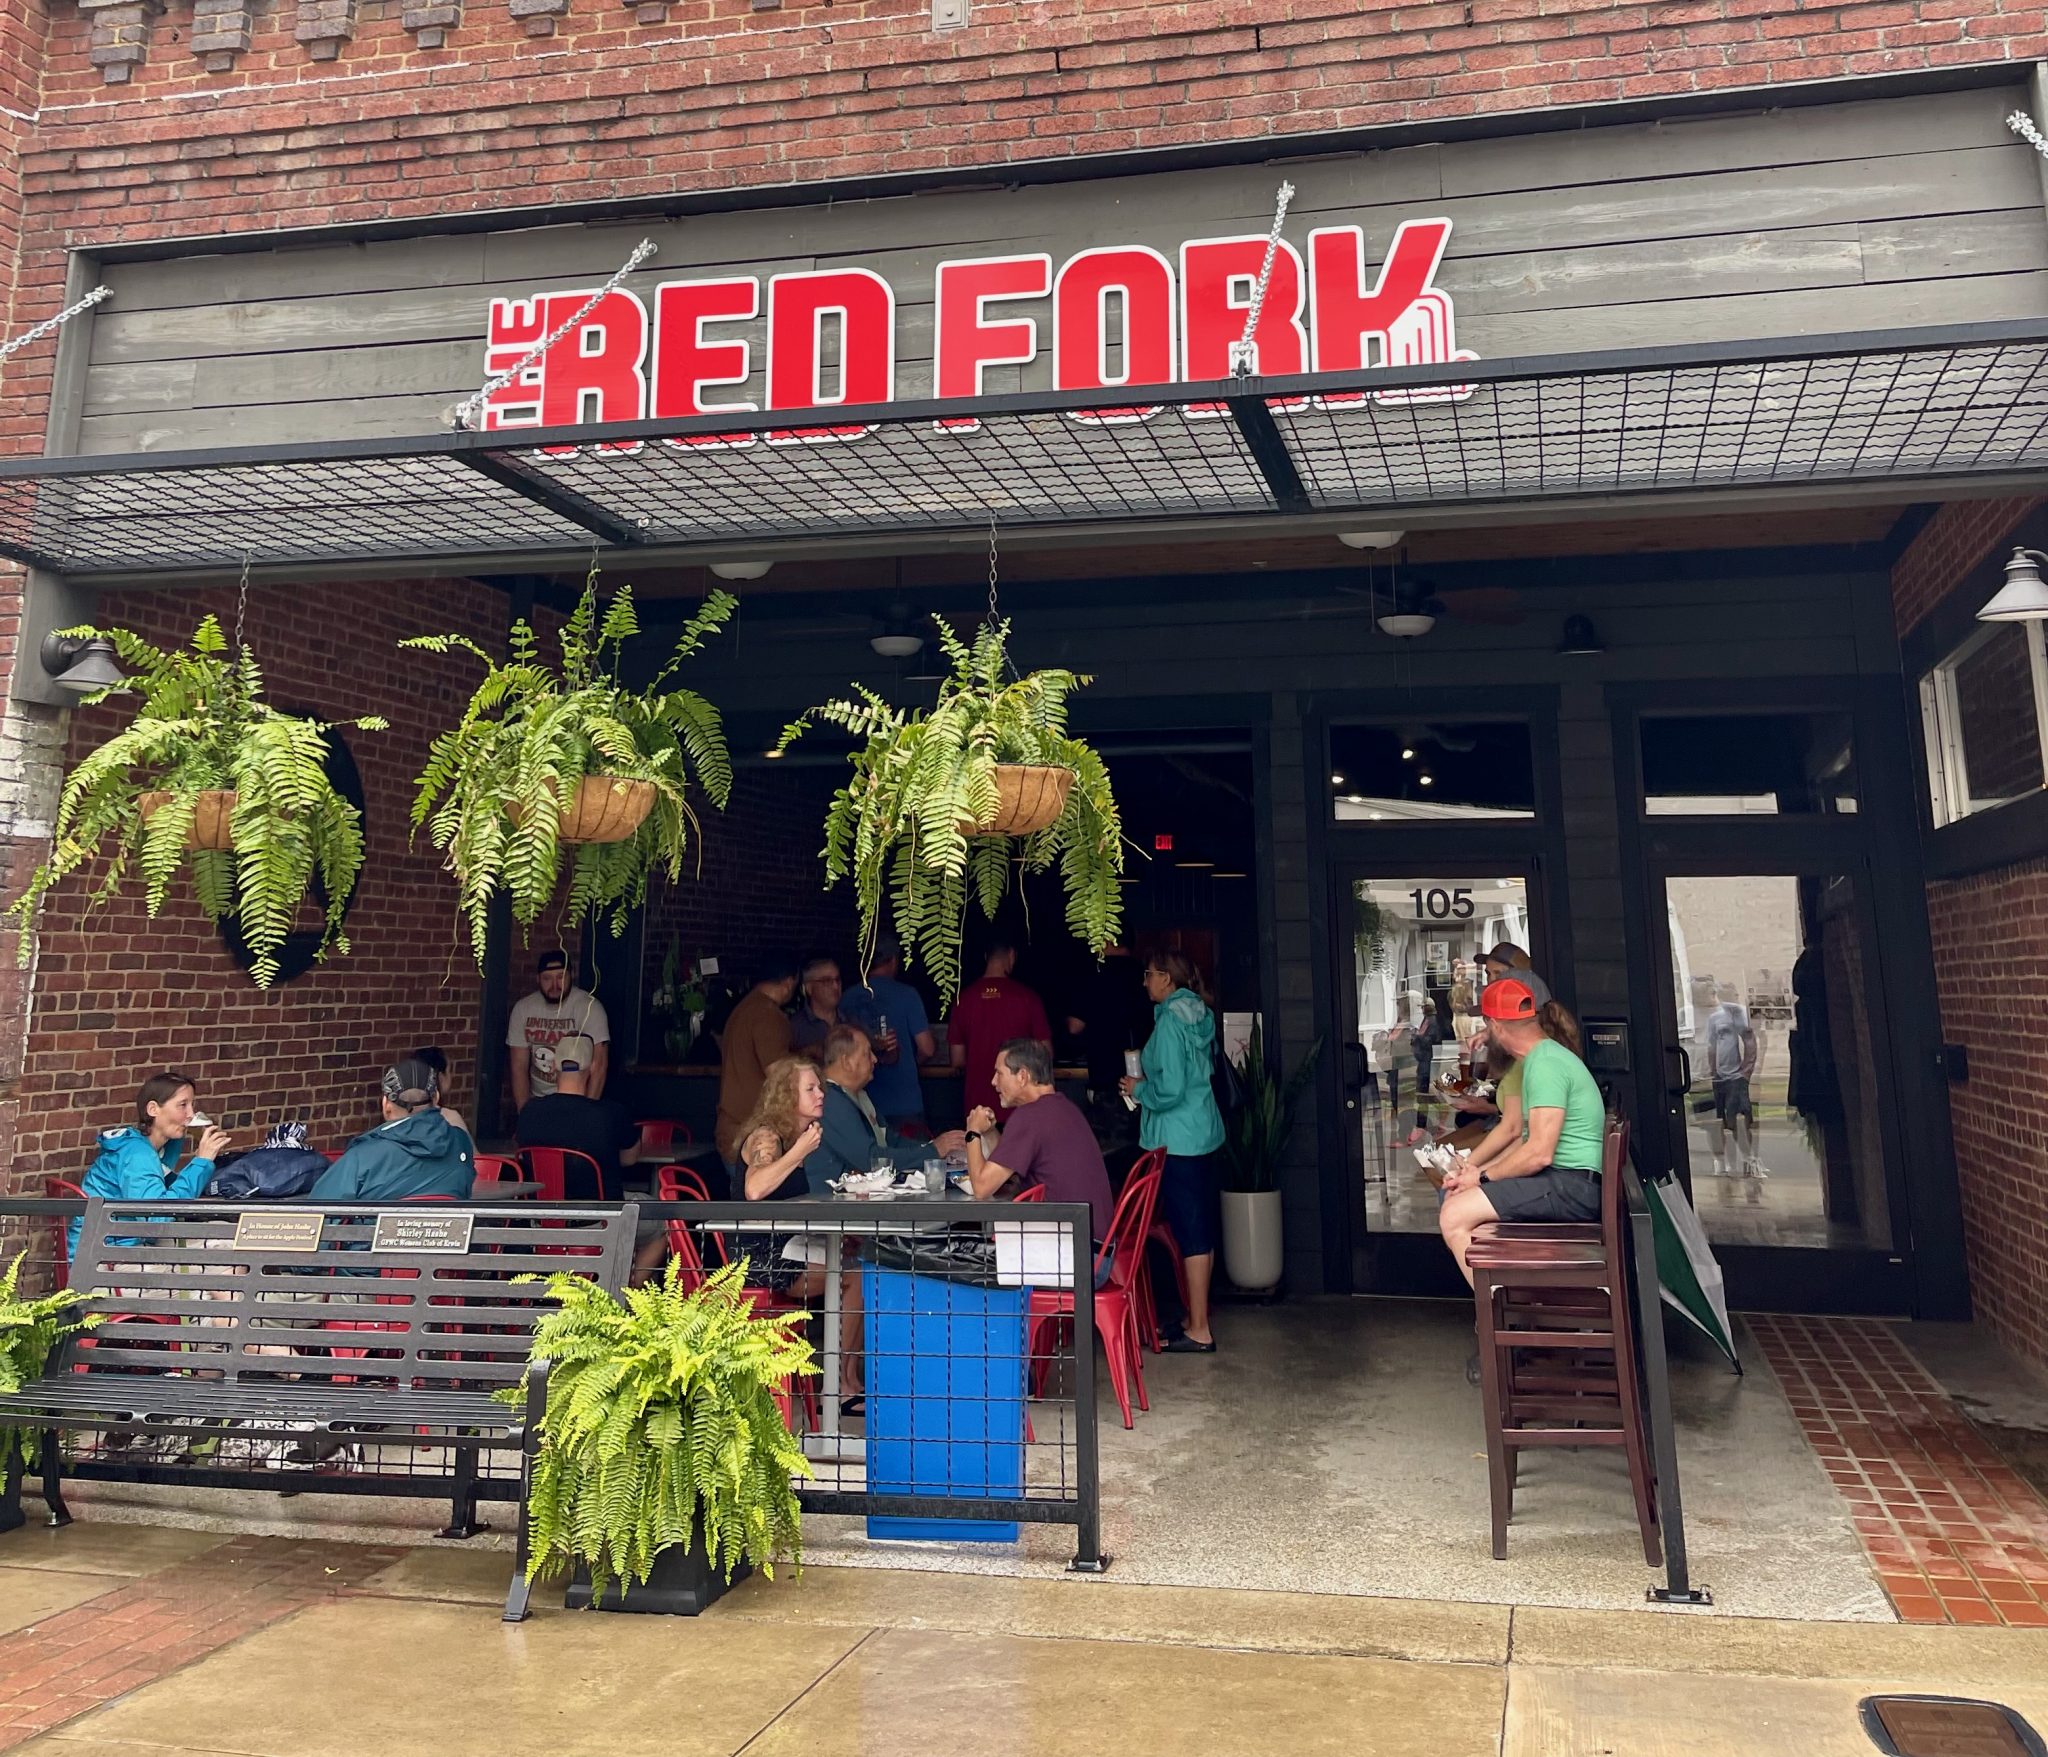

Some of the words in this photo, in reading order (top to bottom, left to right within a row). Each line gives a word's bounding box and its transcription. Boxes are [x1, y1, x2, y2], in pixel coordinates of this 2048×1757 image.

[534, 267, 896, 461] RED
[933, 217, 1481, 435] FORK
[1155, 835, 1173, 850] EXIT
[1409, 888, 1475, 918] 105
[397, 1228, 423, 1238] Shirley
